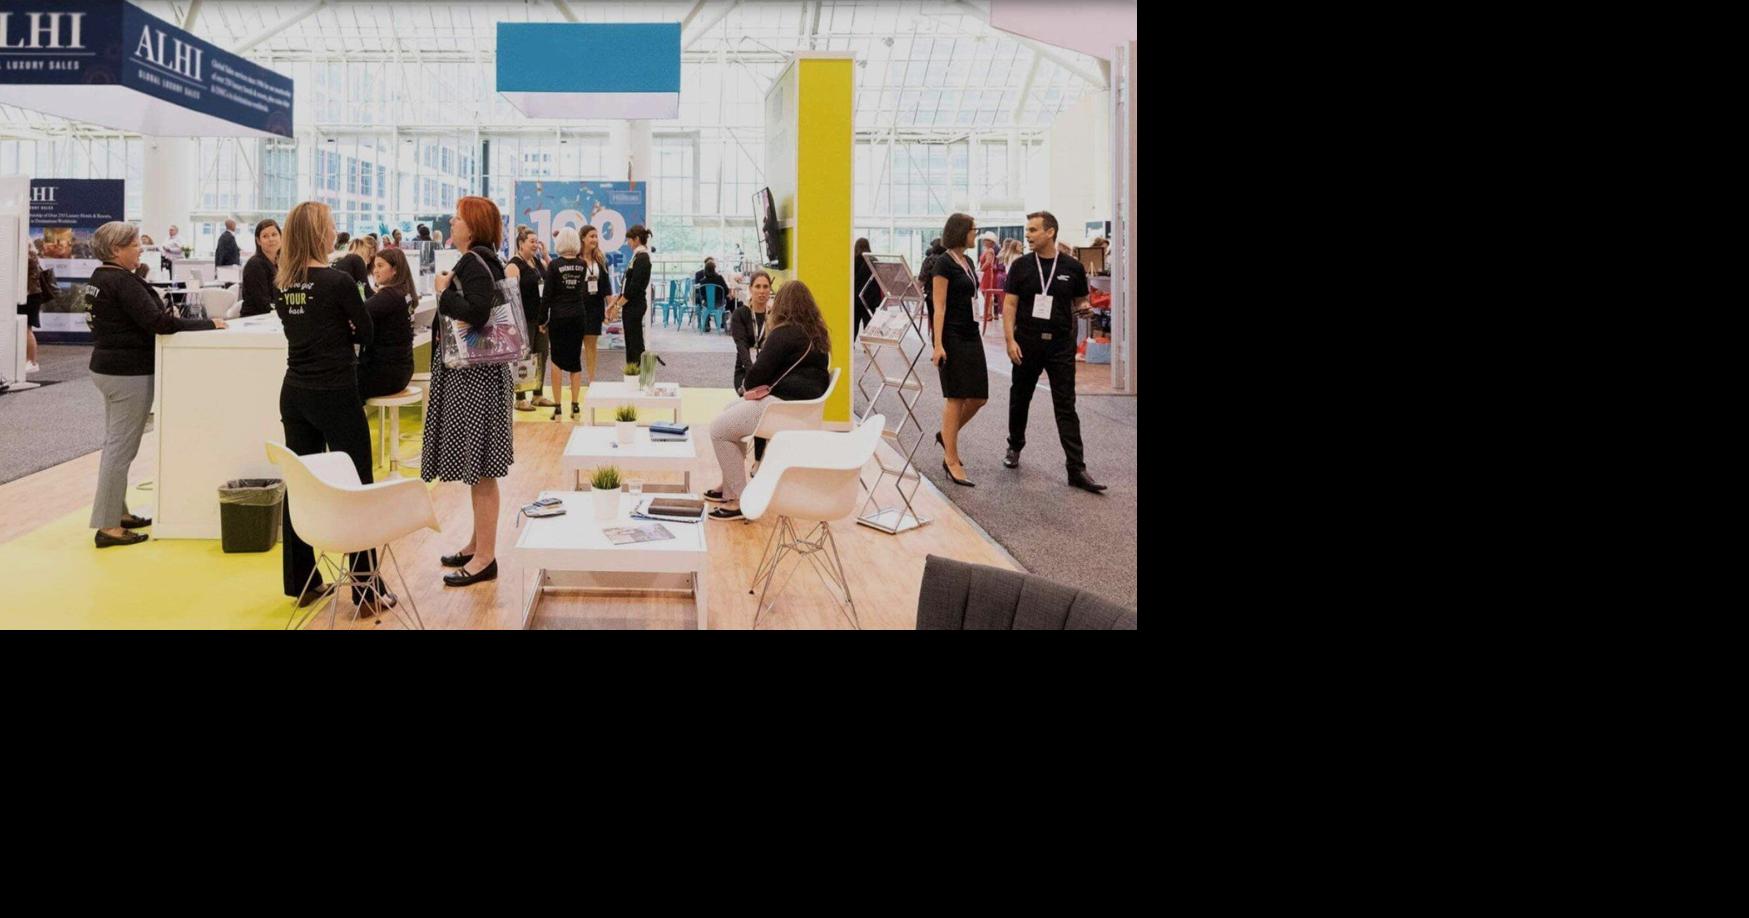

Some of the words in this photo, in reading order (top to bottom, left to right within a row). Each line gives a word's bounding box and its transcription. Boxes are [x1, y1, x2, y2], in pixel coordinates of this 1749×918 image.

[134, 24, 204, 81] ALHI
[6, 61, 44, 70] LUXURY
[49, 61, 79, 70] SALES
[138, 69, 161, 86] GLOBAL
[30, 186, 56, 202] HI
[529, 209, 627, 257] 100
[284, 292, 307, 305] YOUR
[288, 305, 305, 315] back
